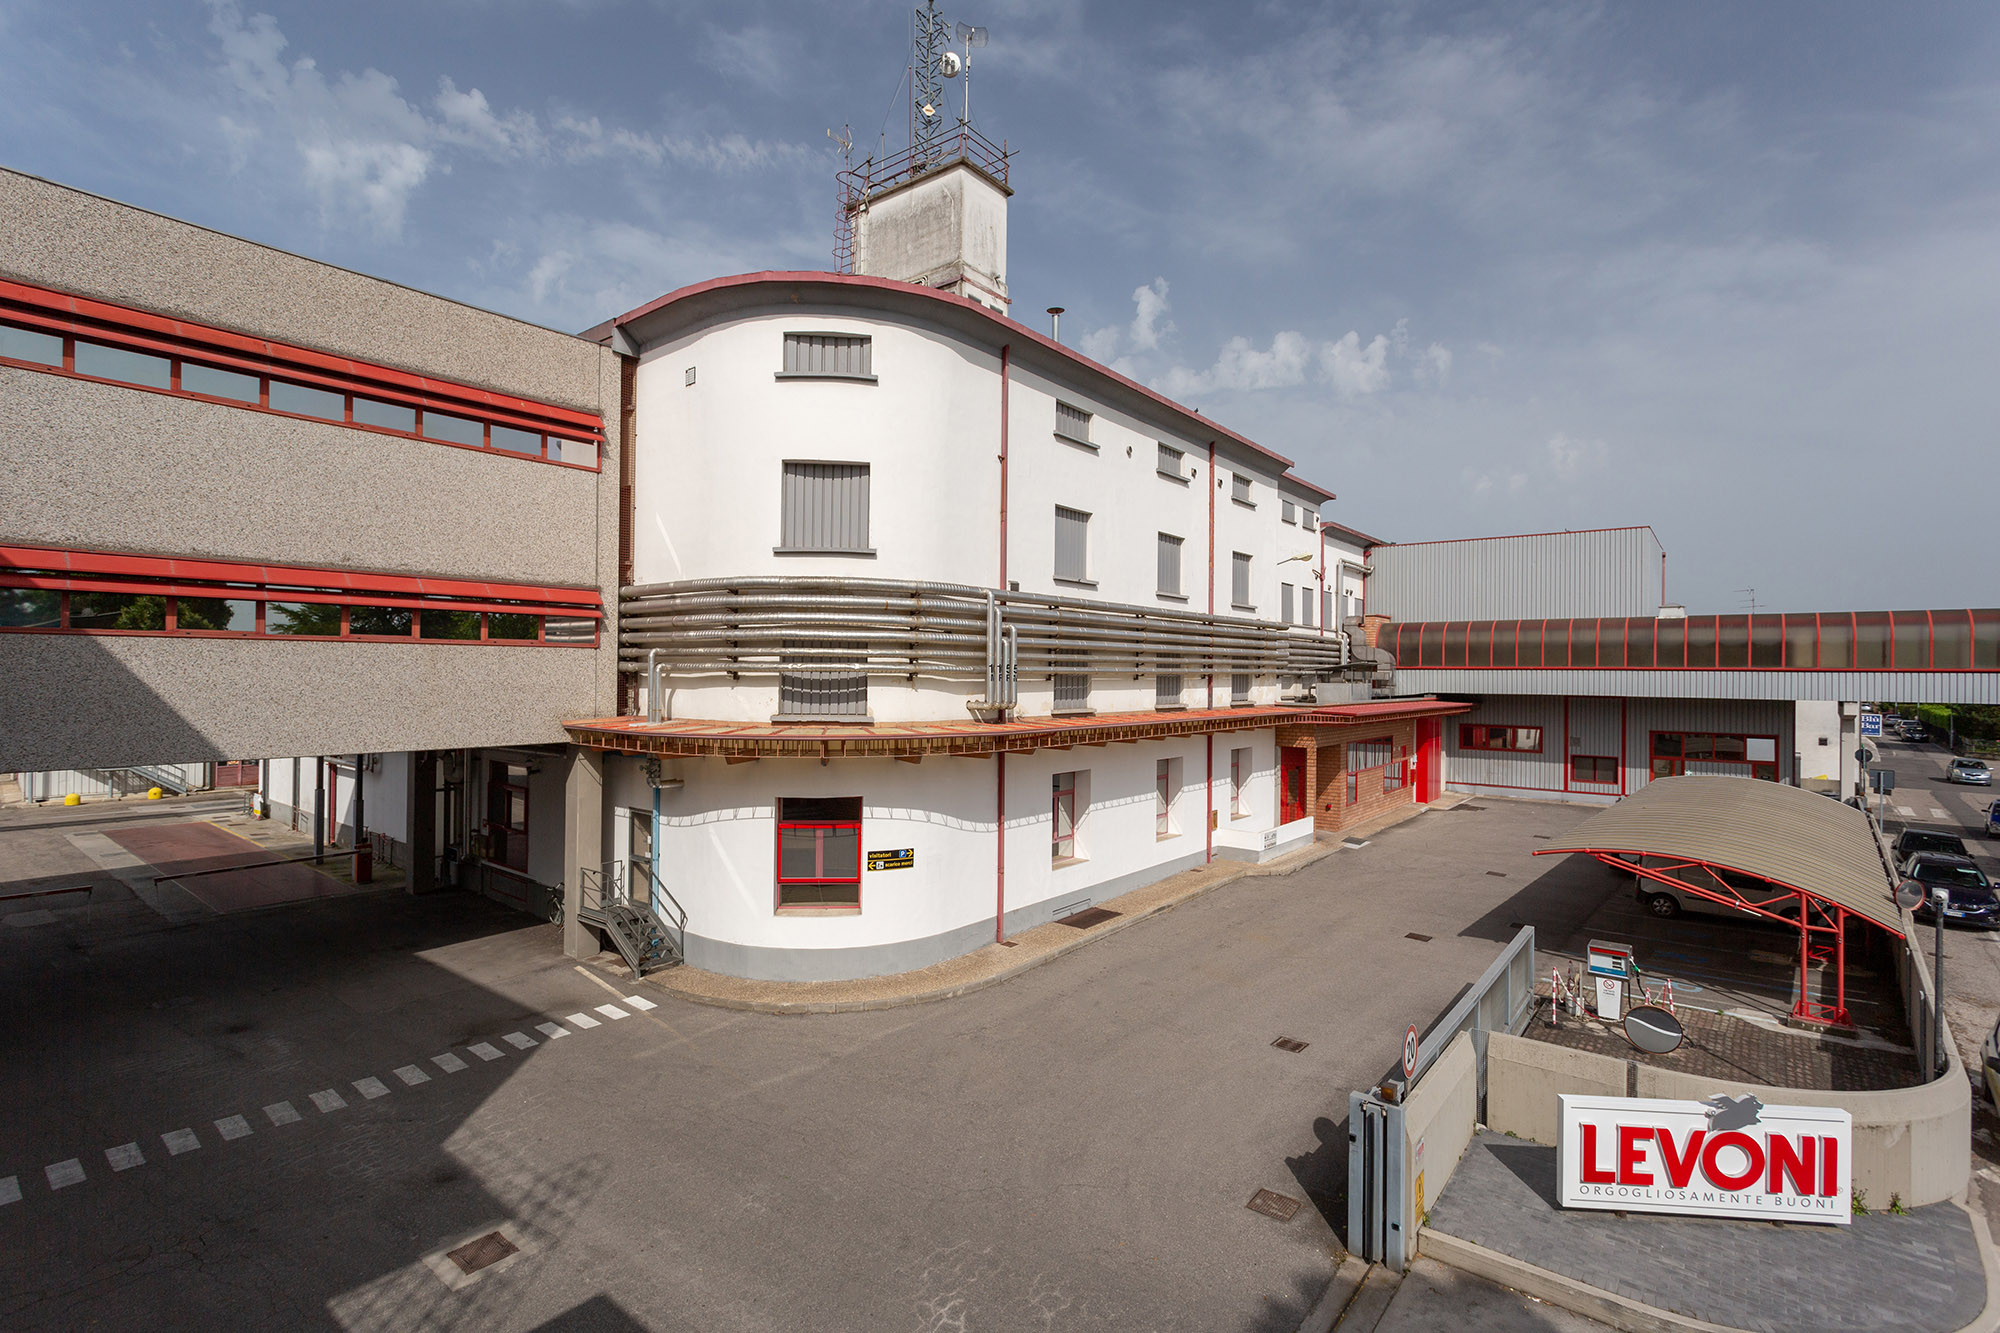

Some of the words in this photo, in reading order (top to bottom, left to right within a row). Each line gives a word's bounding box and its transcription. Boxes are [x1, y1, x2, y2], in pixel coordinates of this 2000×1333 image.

[1406, 1037, 1415, 1065] 20
[1579, 1122, 1838, 1198] LEVONI
[1579, 1185, 1763, 1205] ORGOGLIOSAMENTE
[1774, 1196, 1835, 1209] BUONI
